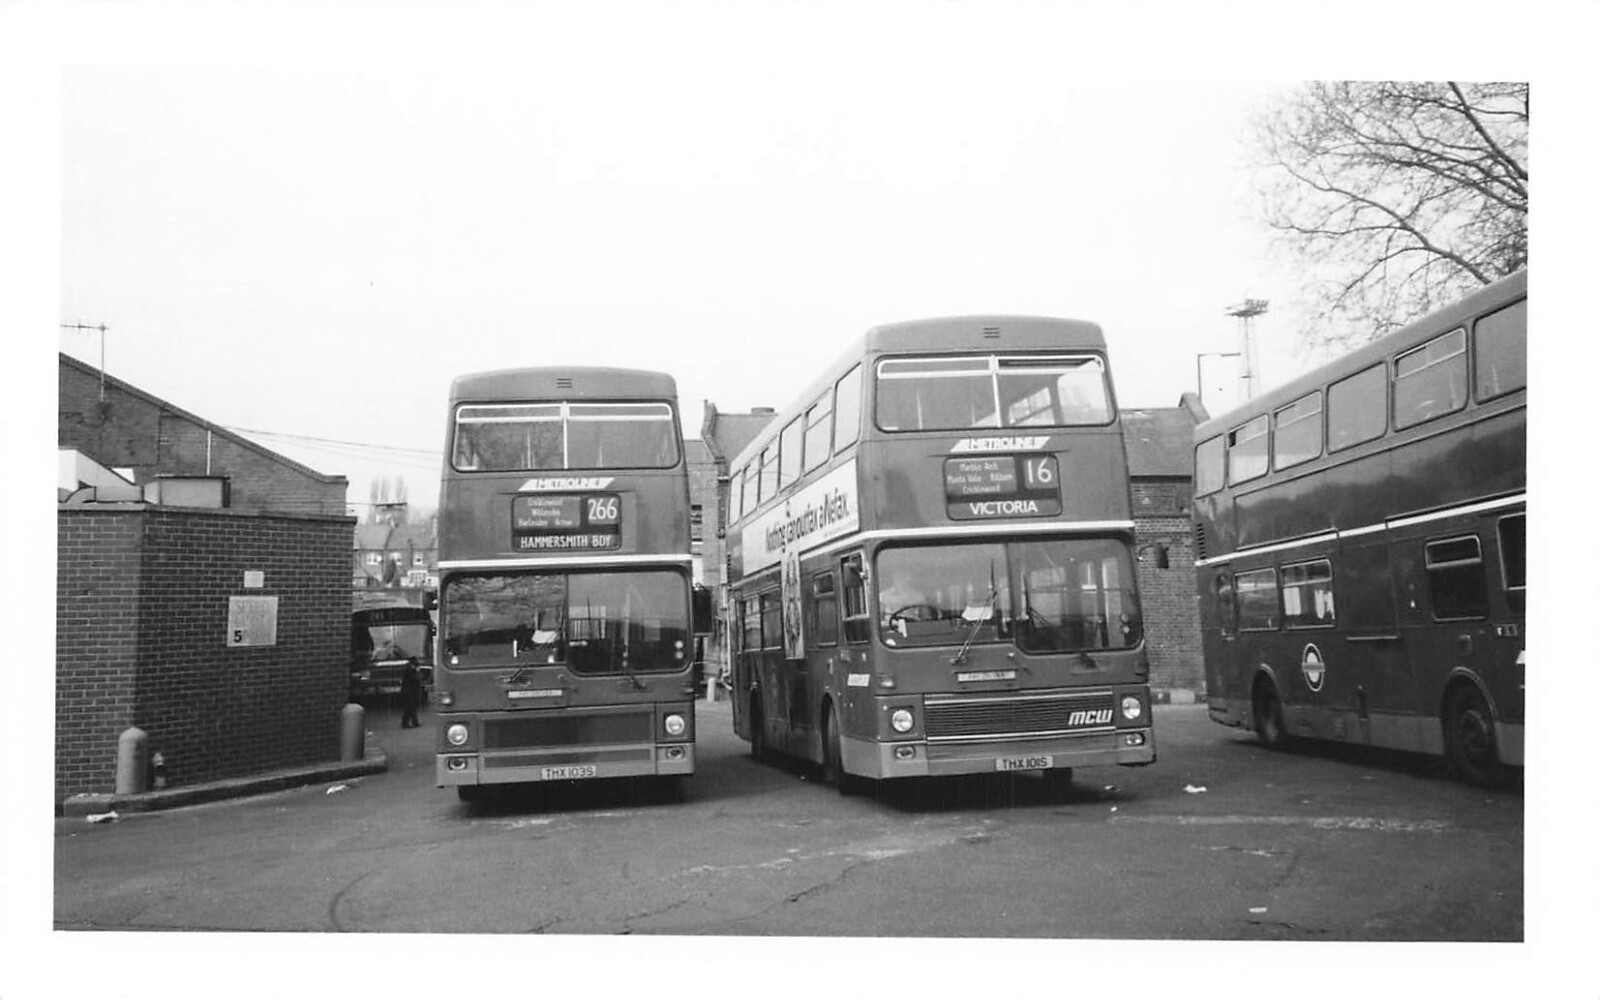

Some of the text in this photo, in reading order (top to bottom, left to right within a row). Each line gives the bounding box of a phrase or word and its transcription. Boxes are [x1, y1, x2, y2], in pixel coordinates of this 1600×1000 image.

[1027, 457, 1052, 483] 16
[587, 497, 618, 520] 266
[969, 500, 1038, 515] VICTORIA
[520, 535, 588, 549] HAMMERSMITH
[234, 630, 242, 643] 5
